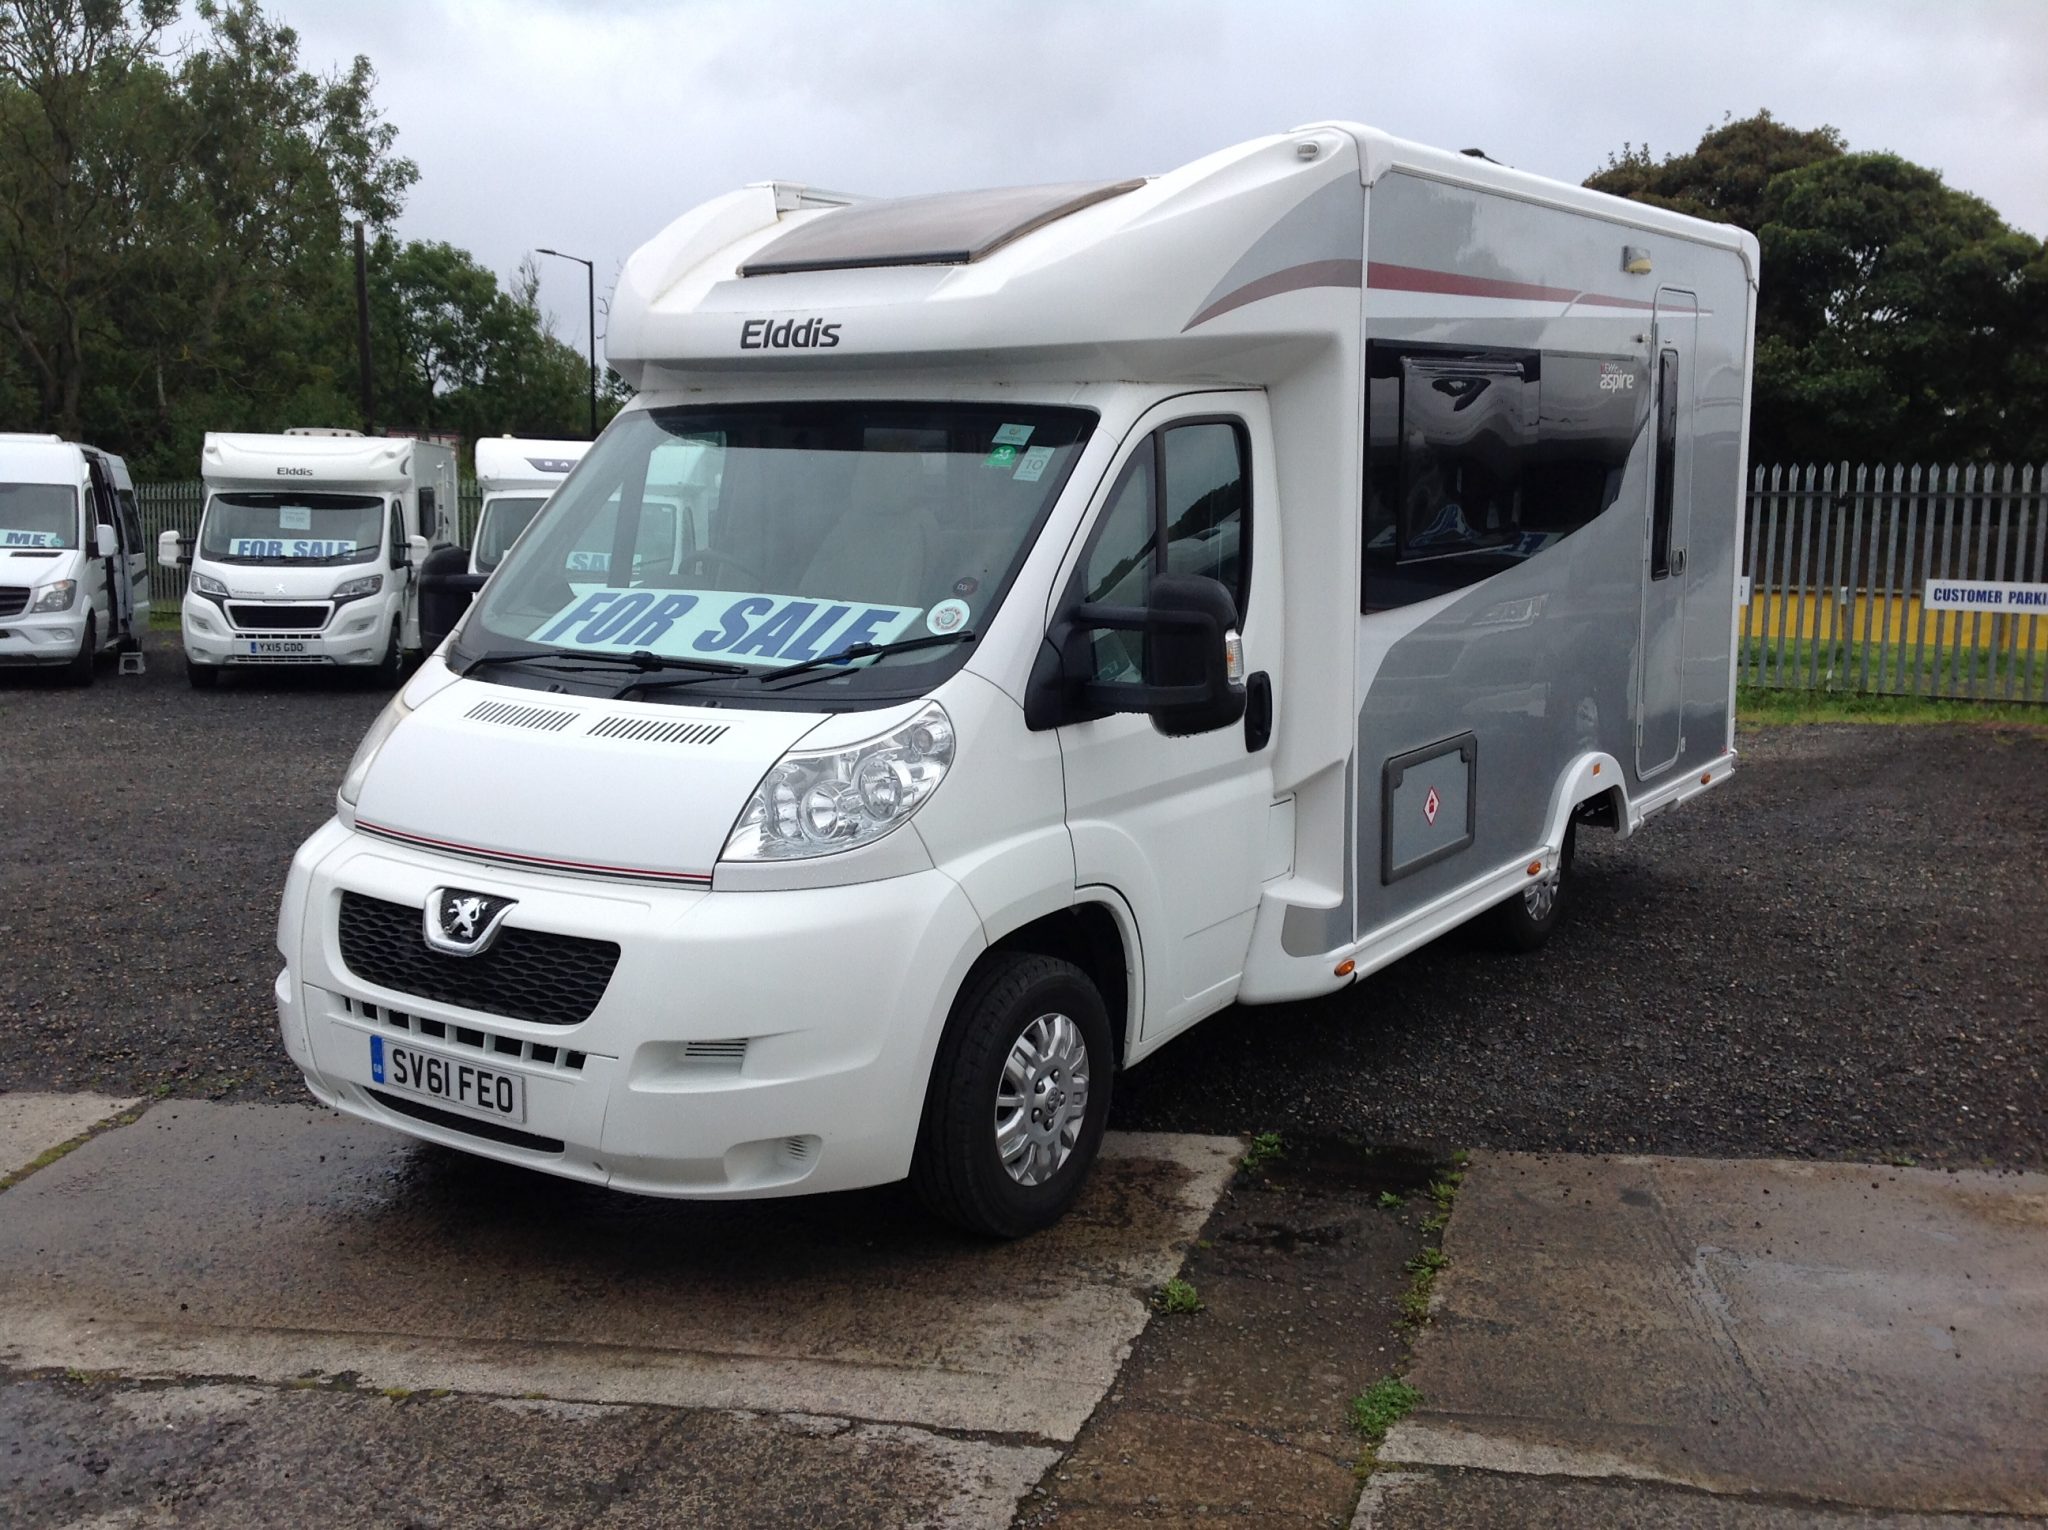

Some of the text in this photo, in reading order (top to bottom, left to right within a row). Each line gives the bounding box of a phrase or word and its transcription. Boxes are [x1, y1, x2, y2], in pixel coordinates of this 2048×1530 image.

[740, 317, 842, 350] Elddis
[1600, 369, 1634, 392] aspire
[276, 467, 313, 477] Elddis
[6, 532, 46, 546] ME
[238, 540, 350, 557] FOR SALE
[1933, 588, 2048, 606] CUSTOMER PARKI
[539, 592, 901, 666] FOR SALE
[392, 1048, 450, 1097] SV61
[459, 1065, 513, 1114] FEO
